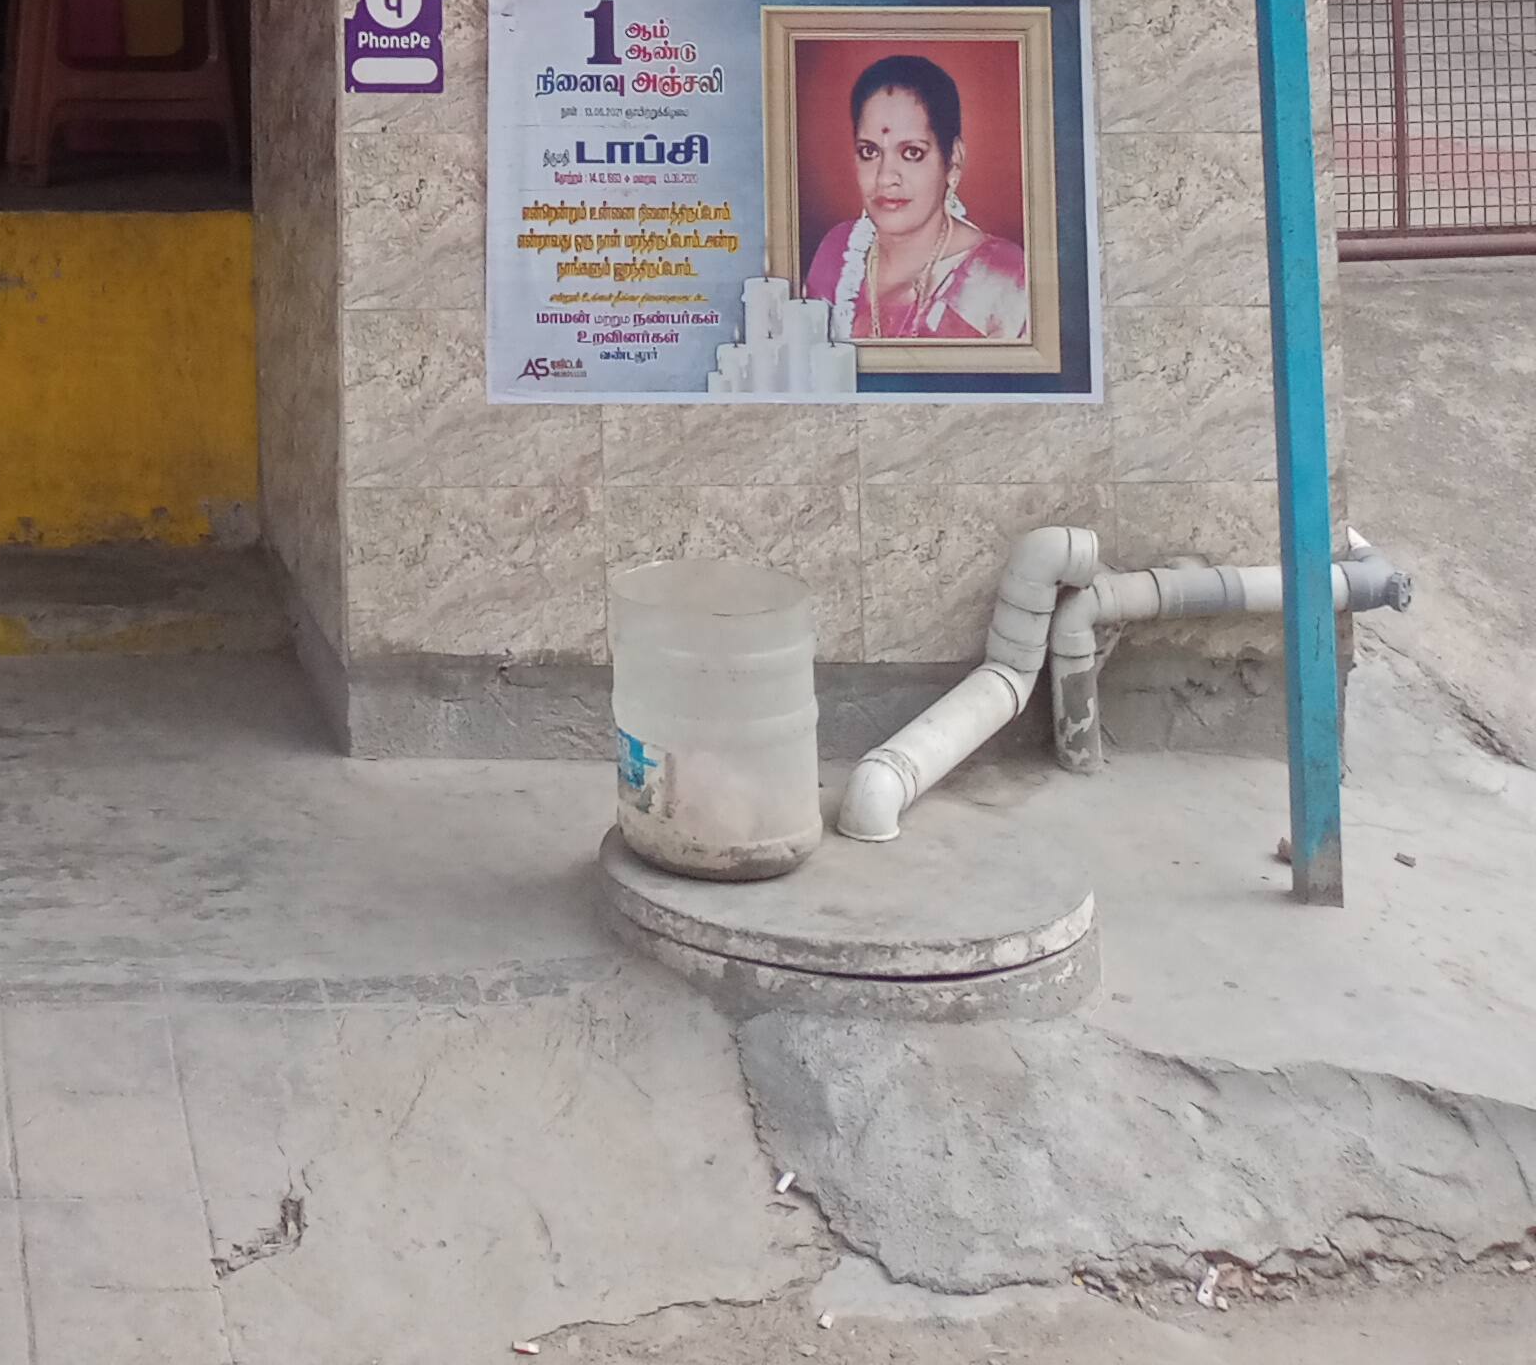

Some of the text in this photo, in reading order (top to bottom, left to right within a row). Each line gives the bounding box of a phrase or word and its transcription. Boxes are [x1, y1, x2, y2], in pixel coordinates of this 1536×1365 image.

[357, 31, 431, 49] PhonePe
[584, 0, 670, 65] 1 ஆம்
[625, 40, 697, 63] ஆண்டு
[535, 65, 724, 98] நினைவு அஞ்சலி
[575, 133, 709, 165] டாப்சி
[536, 309, 590, 324] மாமன்
[632, 310, 720, 327] நண்பர்கள்
[576, 328, 680, 346] உறவினர்கள்
